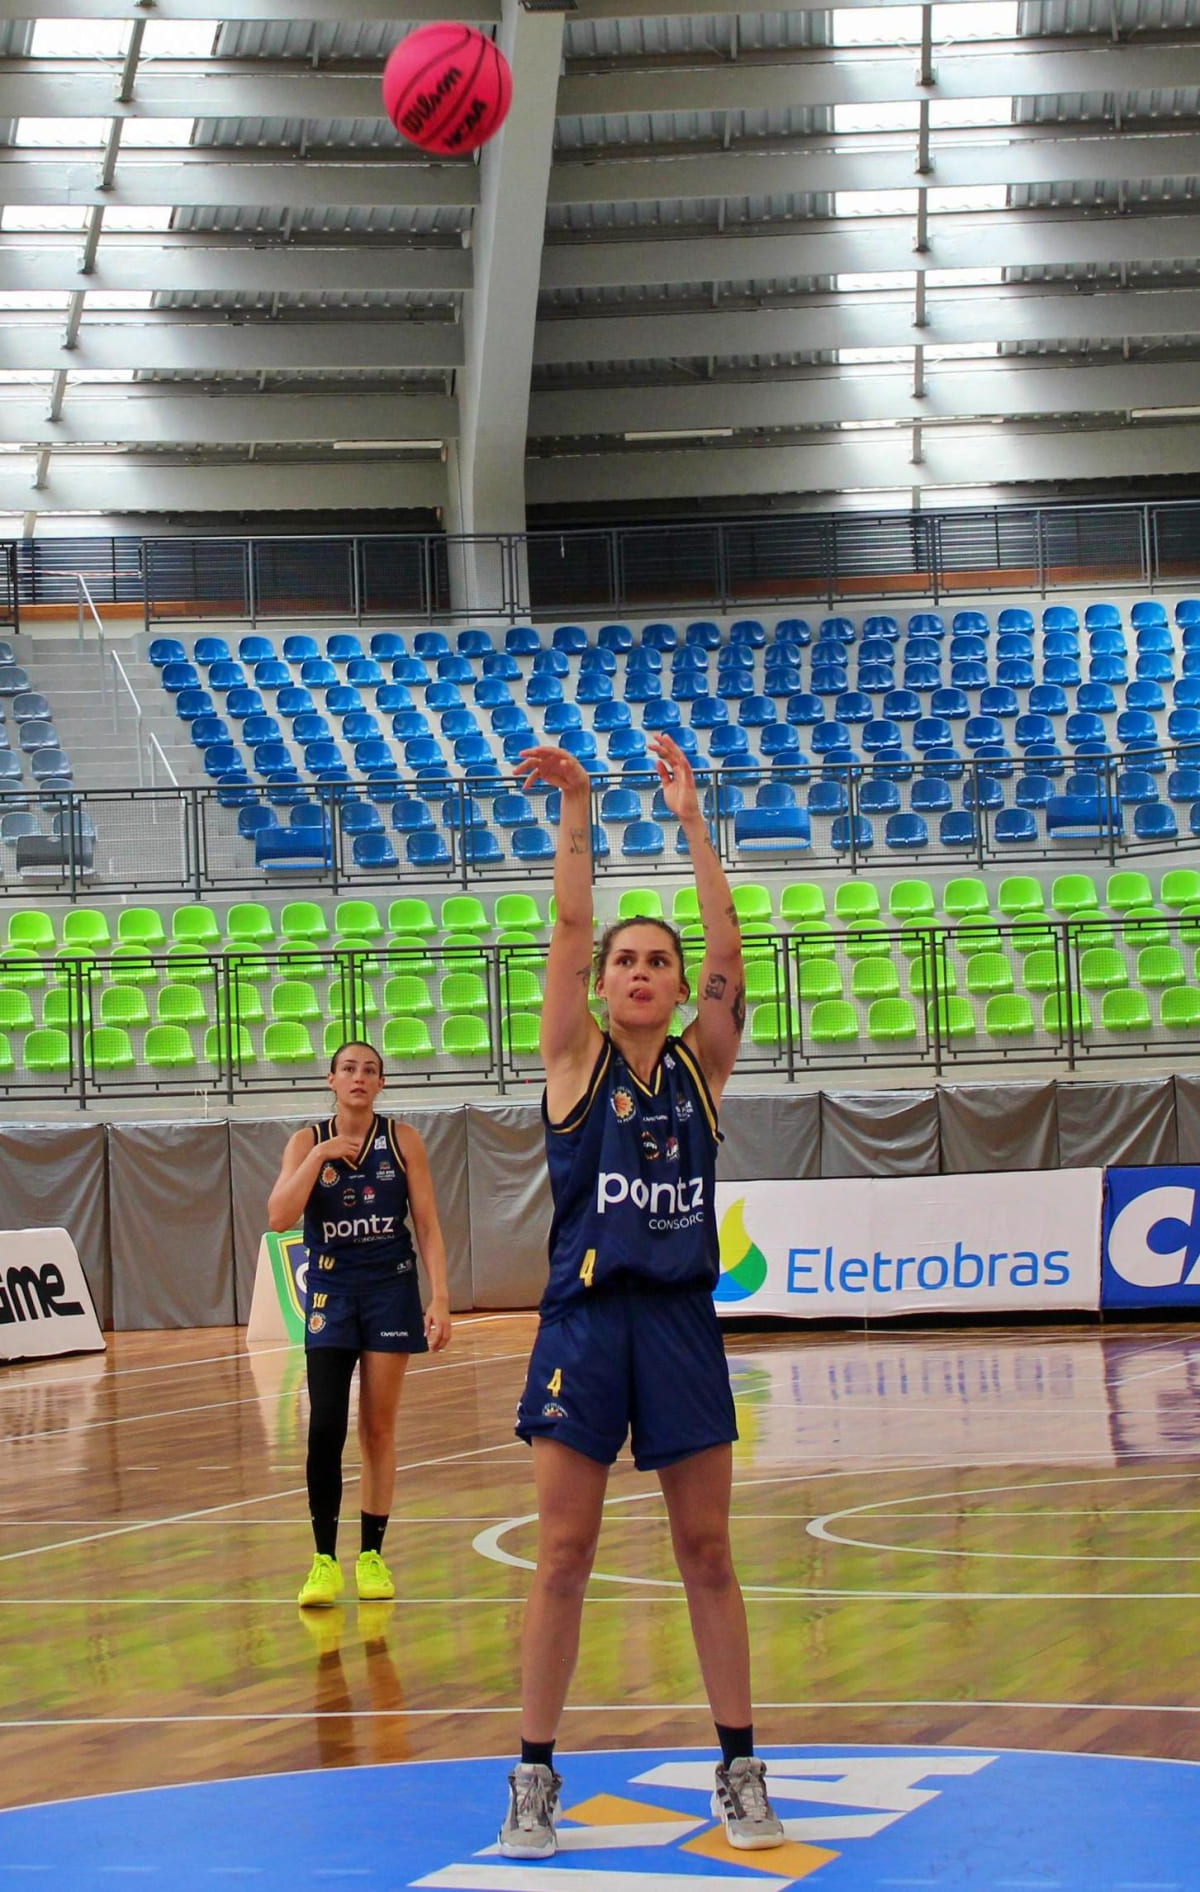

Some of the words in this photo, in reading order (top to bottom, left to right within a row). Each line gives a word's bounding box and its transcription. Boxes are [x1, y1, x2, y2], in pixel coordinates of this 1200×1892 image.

[597, 1171, 704, 1214] pontz
[322, 1214, 395, 1244] pontz
[1107, 1185, 1200, 1288] C
[579, 1248, 597, 1288] 4
[786, 1242, 1070, 1294] Eletrobras
[547, 1367, 563, 1398] 4
